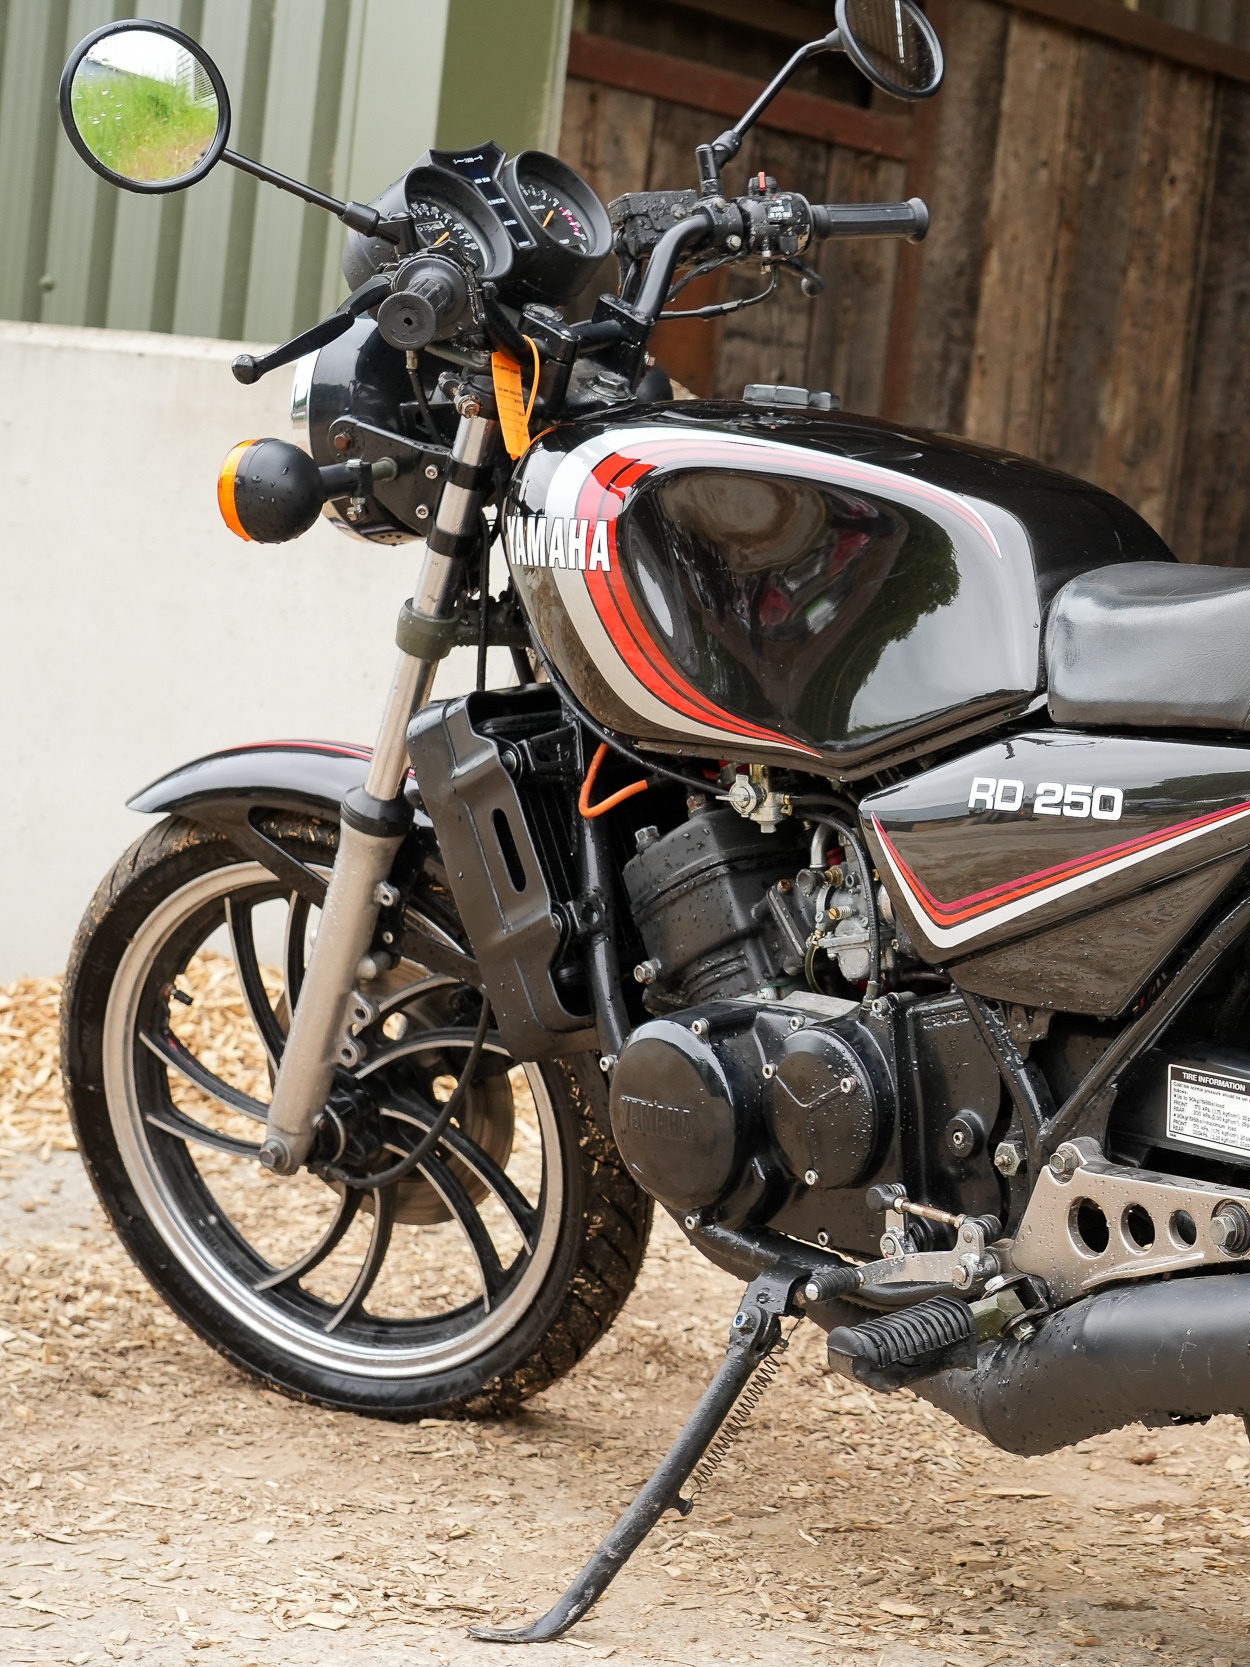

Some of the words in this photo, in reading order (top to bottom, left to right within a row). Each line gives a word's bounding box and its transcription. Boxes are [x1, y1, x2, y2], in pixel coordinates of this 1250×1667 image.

[506, 515, 611, 572] YAMAHA
[967, 776, 1025, 812] RD
[1033, 781, 1124, 821] 250
[1182, 1073, 1198, 1082] TIRE
[1198, 1076, 1246, 1092] INFORMATION
